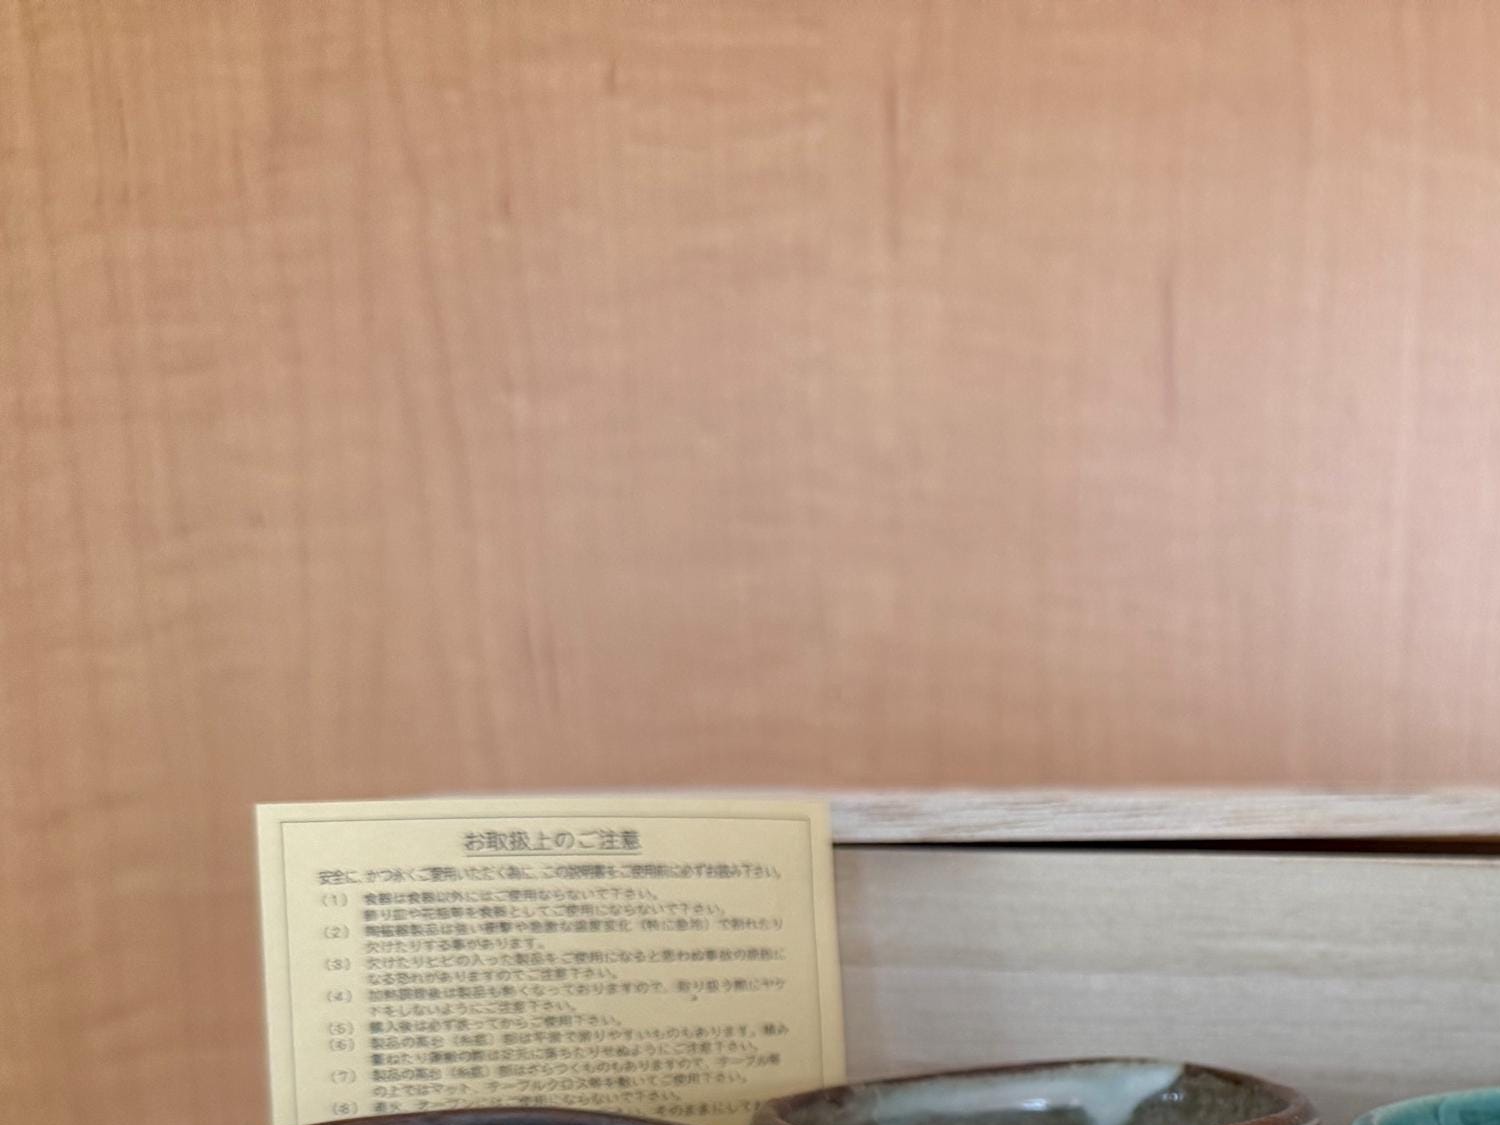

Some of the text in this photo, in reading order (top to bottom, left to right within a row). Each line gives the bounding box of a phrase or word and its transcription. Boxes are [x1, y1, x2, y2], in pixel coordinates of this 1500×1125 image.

[463, 830, 643, 852] お取扱上のご注意
